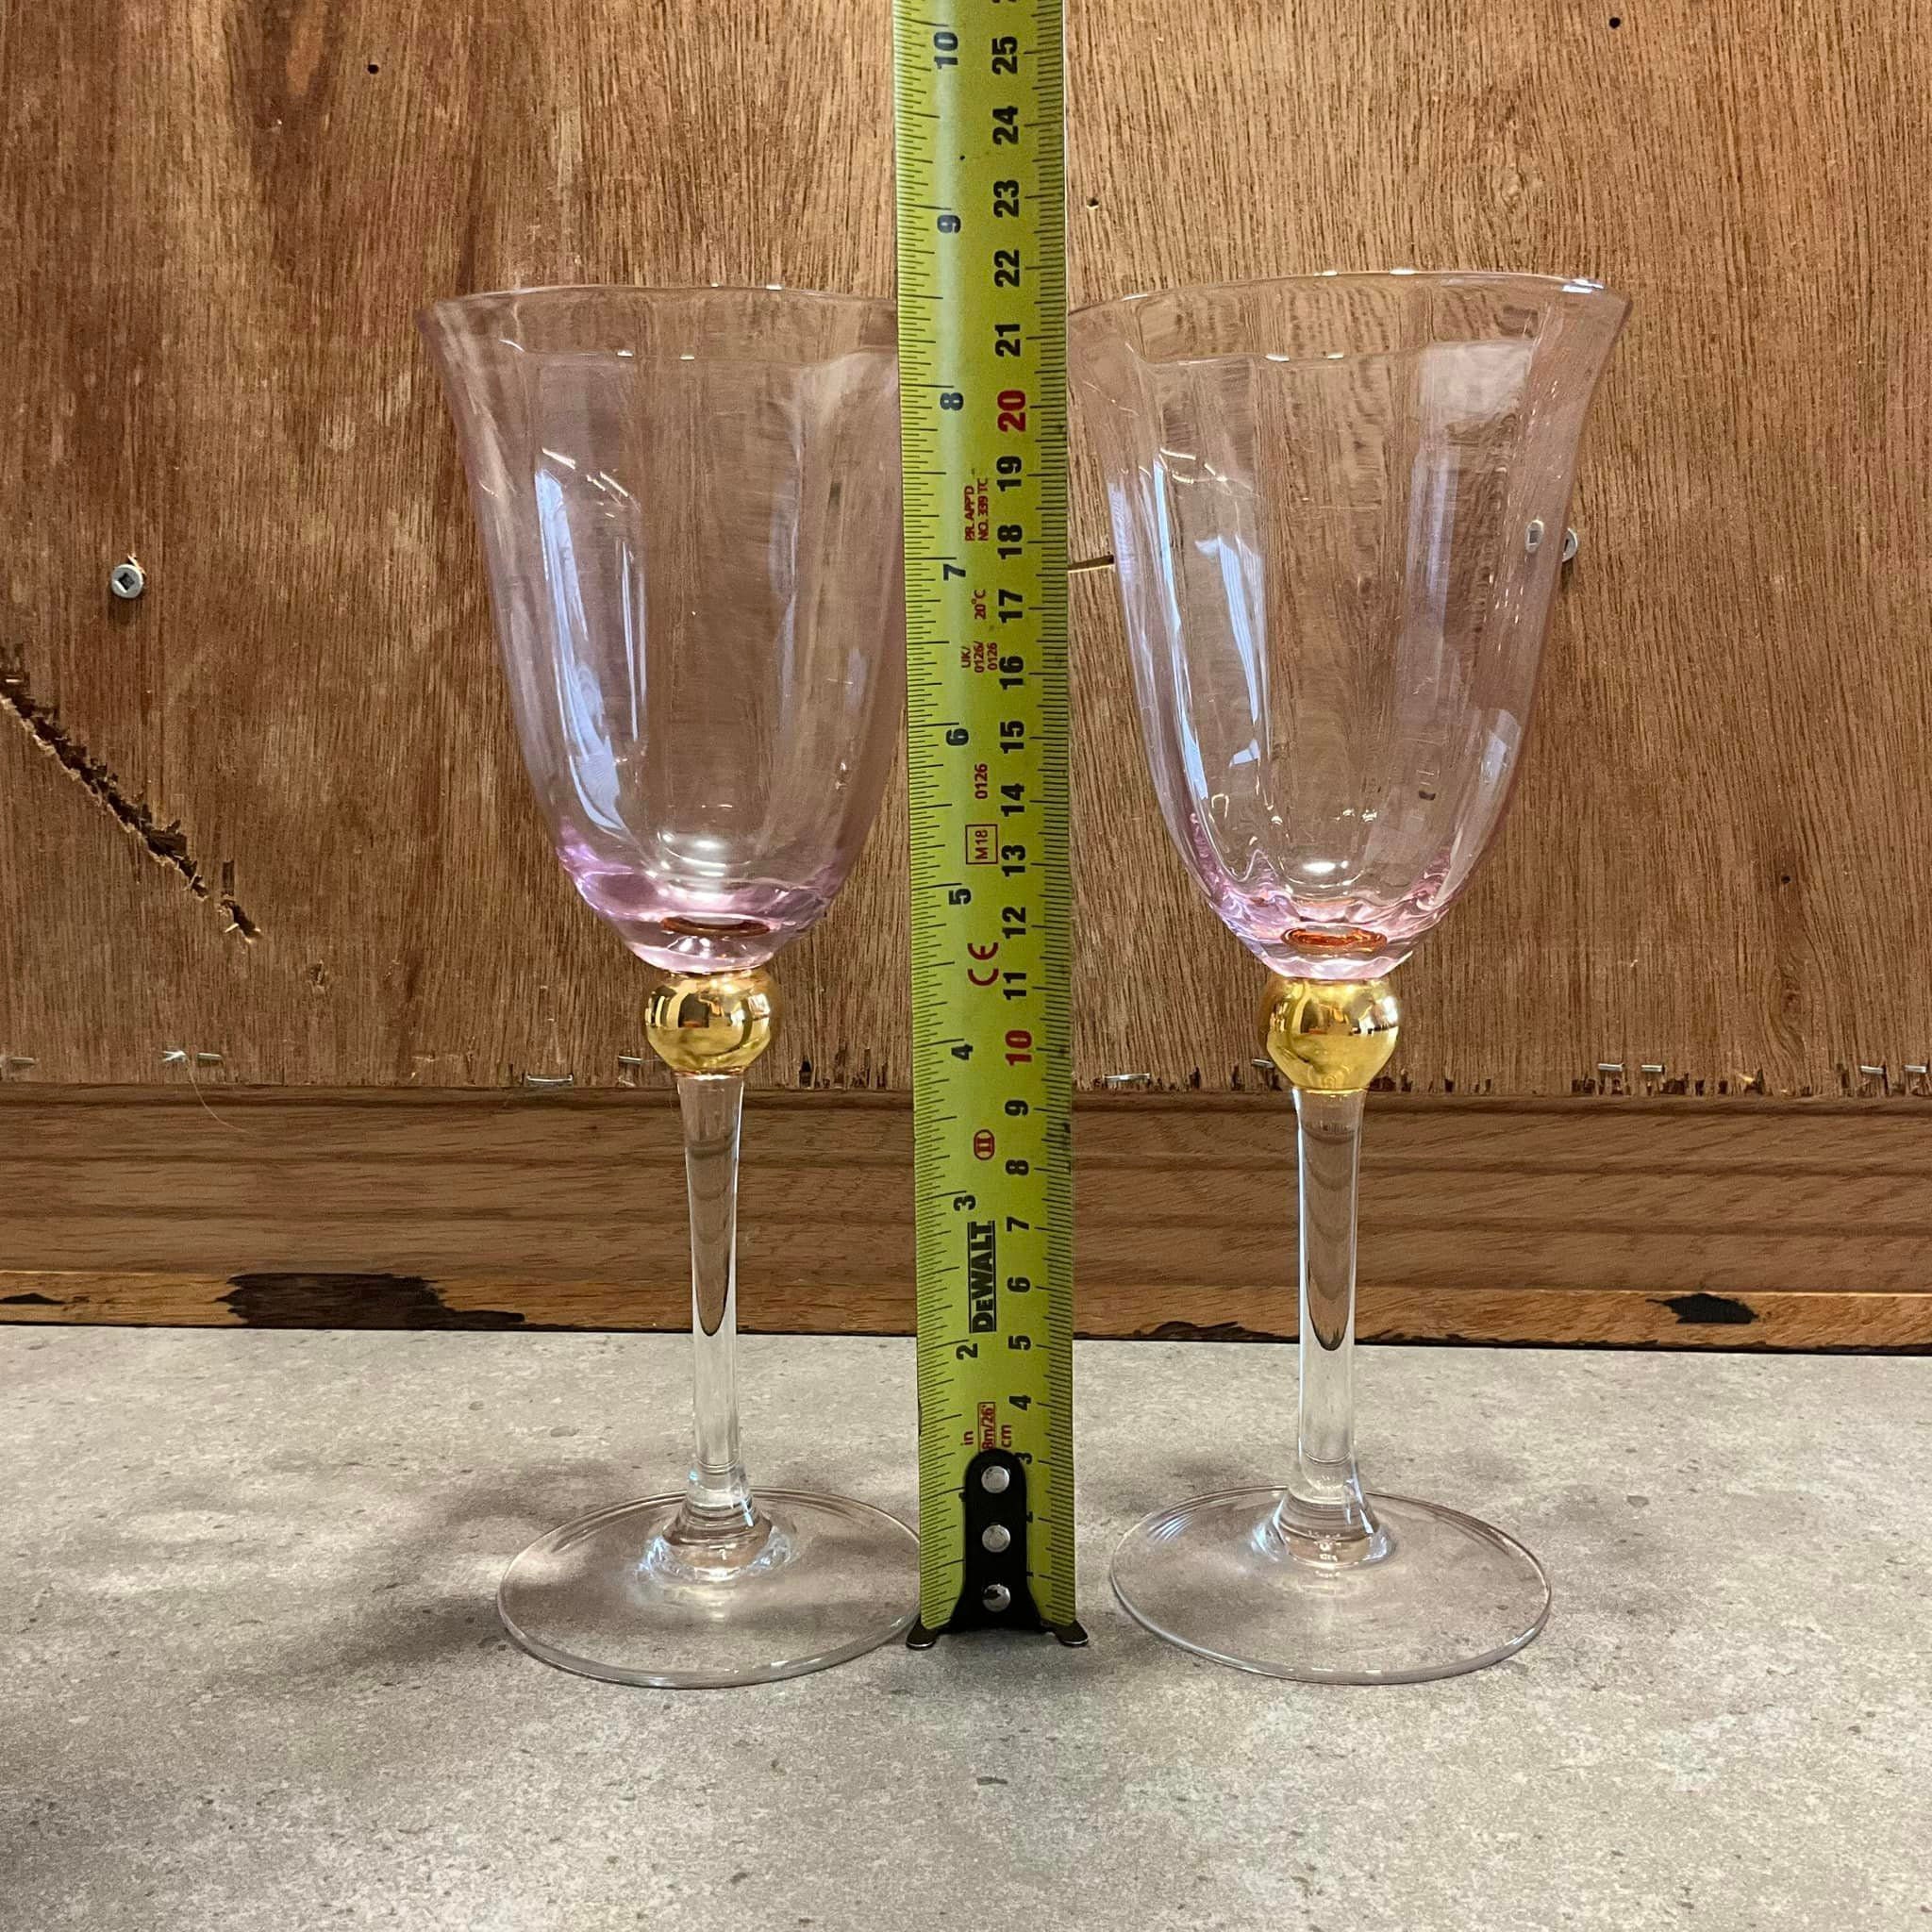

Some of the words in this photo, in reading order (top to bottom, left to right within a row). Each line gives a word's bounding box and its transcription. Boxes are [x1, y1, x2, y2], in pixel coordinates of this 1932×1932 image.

[934, 31, 958, 69] 10
[991, 36, 1018, 75] 25
[992, 106, 1019, 145] 24
[993, 179, 1020, 218] 23
[937, 214, 961, 234] 9
[993, 249, 1020, 288] 22
[994, 324, 1021, 358] 21
[940, 392, 964, 410] 8
[997, 390, 1026, 433] 20
[996, 456, 1023, 492] 19
[997, 525, 1023, 560] 18
[943, 564, 966, 581] 7
[998, 589, 1024, 624] 17
[960, 645, 971, 668] UK/
[973, 641, 985, 673] 0126/
[987, 642, 998, 671] 0126
[999, 656, 1024, 691] 16
[945, 728, 970, 746] 6
[1000, 721, 1024, 754] 15
[974, 763, 988, 799] 0126
[1001, 783, 1024, 817] 14
[1002, 845, 1025, 877] 13
[948, 889, 972, 905] 5
[1002, 907, 1026, 939] 12
[967, 941, 999, 987] CE
[1003, 972, 1026, 1001] 11
[951, 1043, 974, 1060] 4
[1005, 1029, 1033, 1066] 10
[1004, 1099, 1029, 1116] 9
[1005, 1159, 1029, 1175] 8
[953, 1194, 976, 1211] 3
[1007, 1216, 1030, 1232] 7
[970, 1221, 994, 1333] DEWALT
[1007, 1276, 1030, 1293] 6
[956, 1343, 978, 1359] 2
[1008, 1335, 1031, 1351] 5
[1008, 1394, 1032, 1411] 4
[960, 1430, 974, 1446] in
[1001, 1424, 1012, 1448] cm
